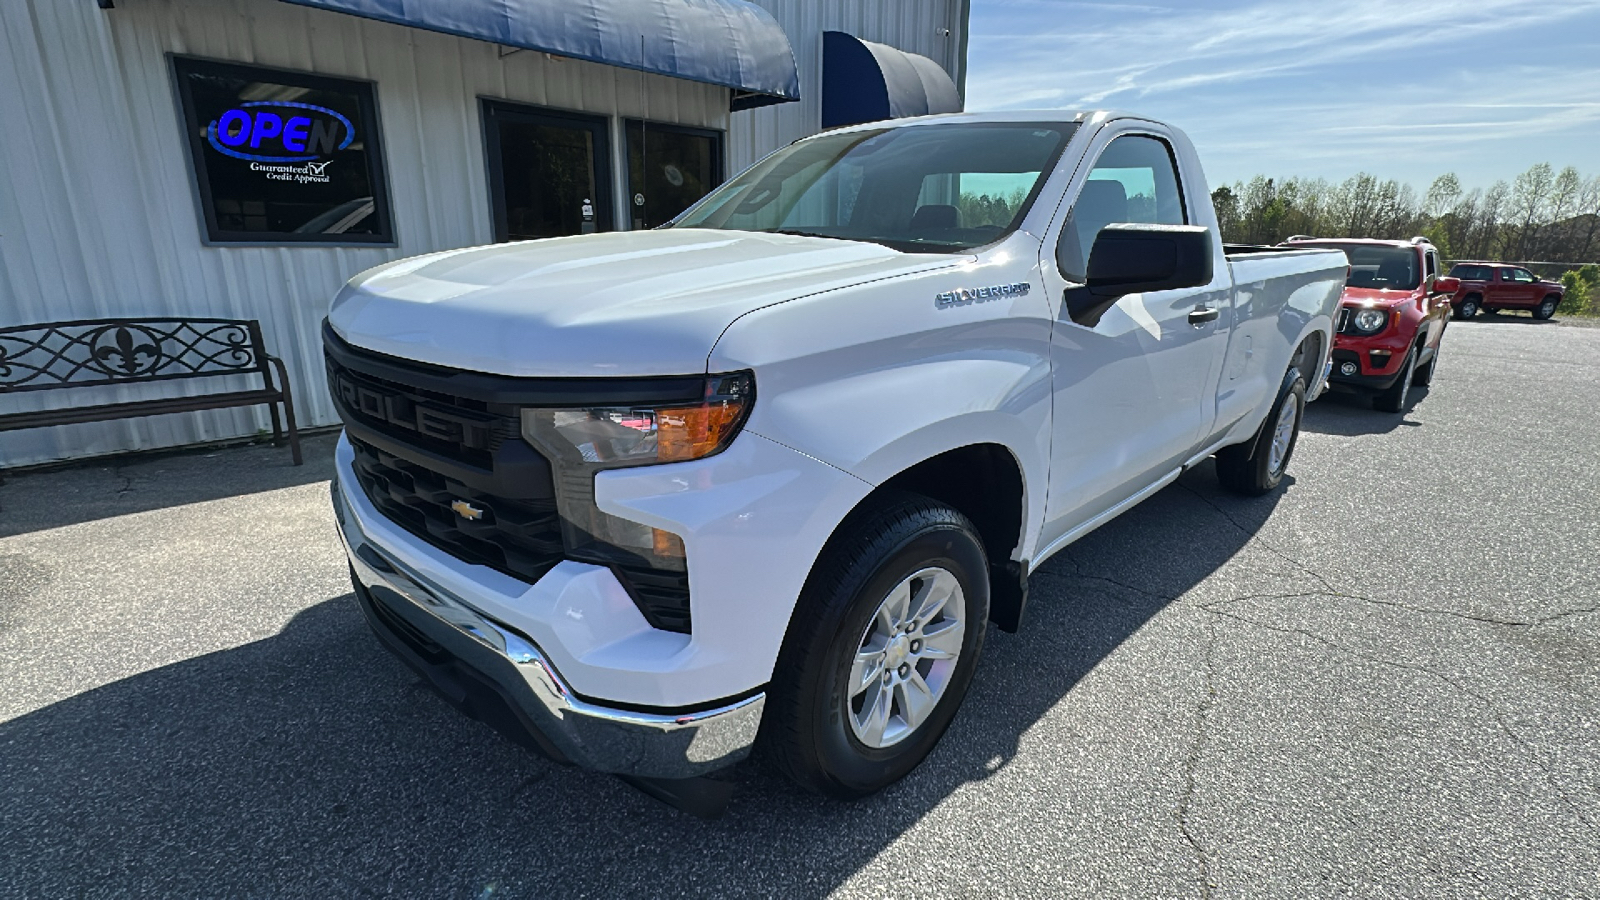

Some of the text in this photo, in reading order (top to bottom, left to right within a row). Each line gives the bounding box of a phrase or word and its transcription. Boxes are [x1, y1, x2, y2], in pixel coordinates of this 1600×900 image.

[218, 109, 339, 154] OPEN
[250, 162, 309, 174] Guaranteed
[266, 172, 331, 184] Credit Approval
[936, 282, 1031, 306] SILVERADO
